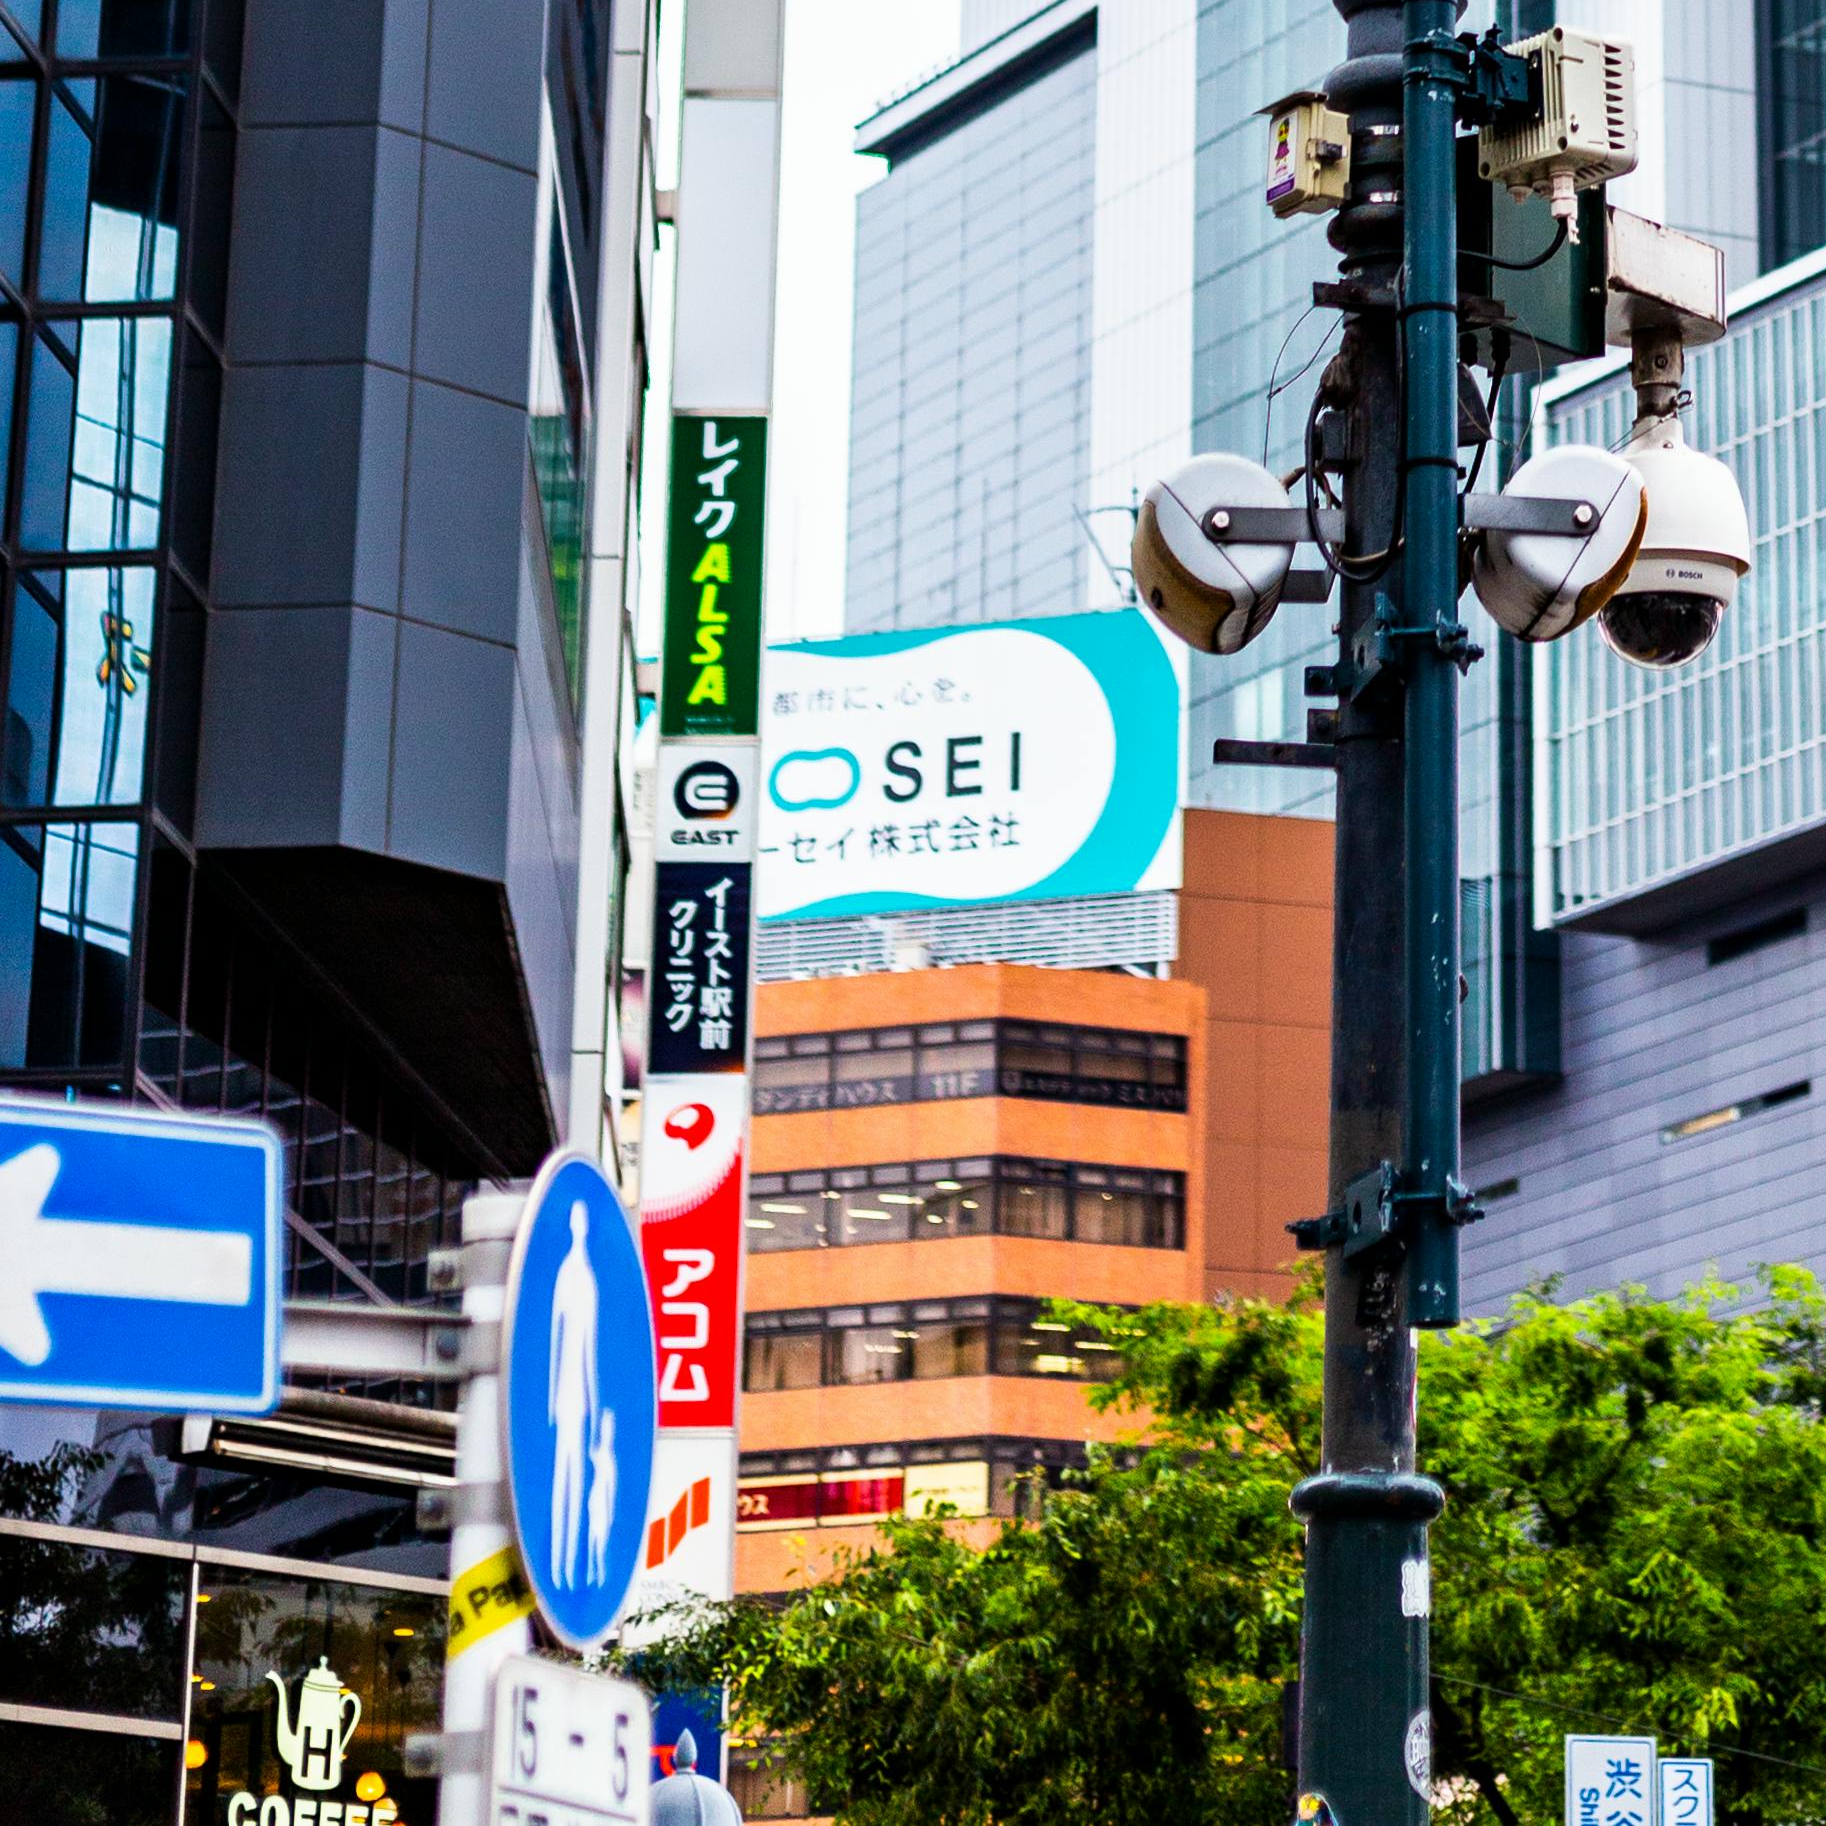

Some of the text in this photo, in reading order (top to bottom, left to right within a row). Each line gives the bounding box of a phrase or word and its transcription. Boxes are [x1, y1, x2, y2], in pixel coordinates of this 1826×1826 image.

[1678, 570, 1703, 580] BOSCH
[882, 731, 1021, 804] SEI
[671, 829, 740, 846] EAST
[665, 900, 698, 1034] クリニック
[699, 876, 735, 1050] イースト駅前
[930, 1070, 981, 1099] 11F
[659, 1248, 716, 1402] アコム
[301, 1726, 333, 1781] H
[612, 1712, 629, 1804] 5
[1672, 1769, 1699, 1826] スク
